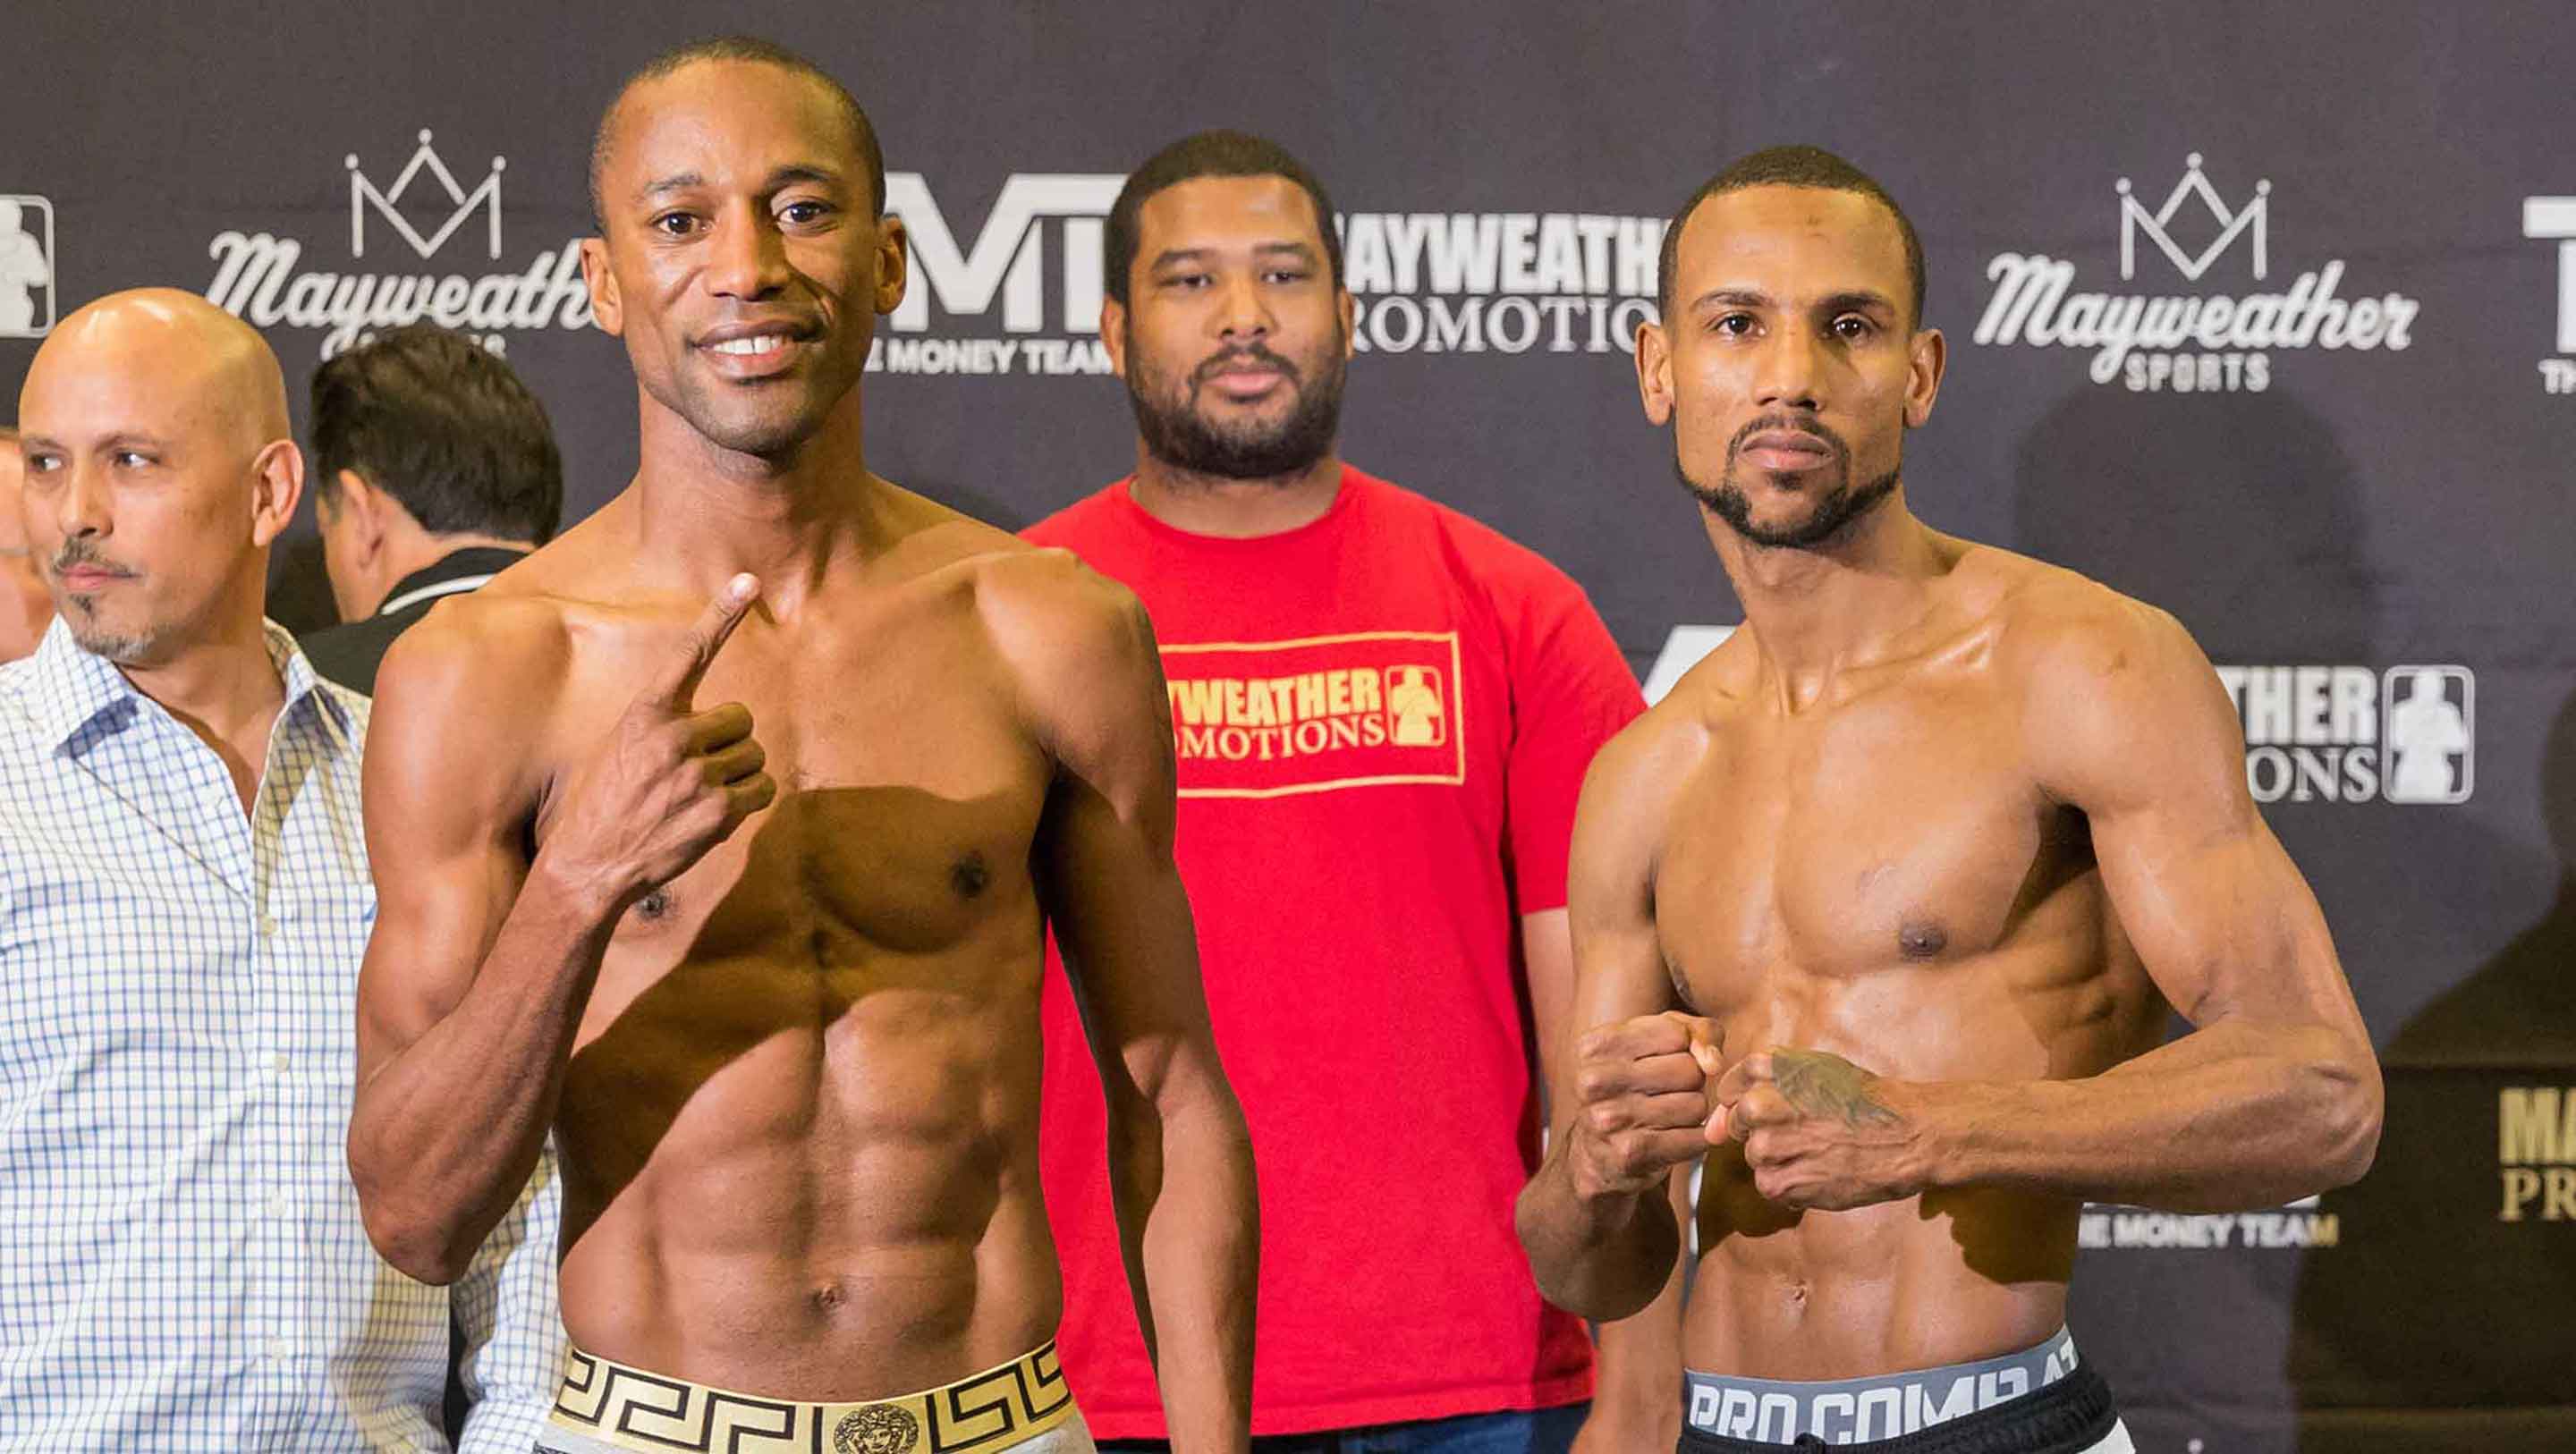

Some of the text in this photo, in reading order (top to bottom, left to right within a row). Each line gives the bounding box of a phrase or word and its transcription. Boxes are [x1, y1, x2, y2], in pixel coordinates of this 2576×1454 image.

[1334, 212, 1670, 296] AYWEATH
[207, 231, 601, 360] Mayweath
[1973, 251, 2419, 385] Mayweather
[887, 338, 1018, 374] MONEY
[2124, 352, 2271, 393] SPORTS
[1174, 714, 1386, 760] MOTIONS
[2114, 1213, 2235, 1248] MONEY
[2238, 1213, 2339, 1248] TEAM
[1689, 1384, 1796, 1443] PRO
